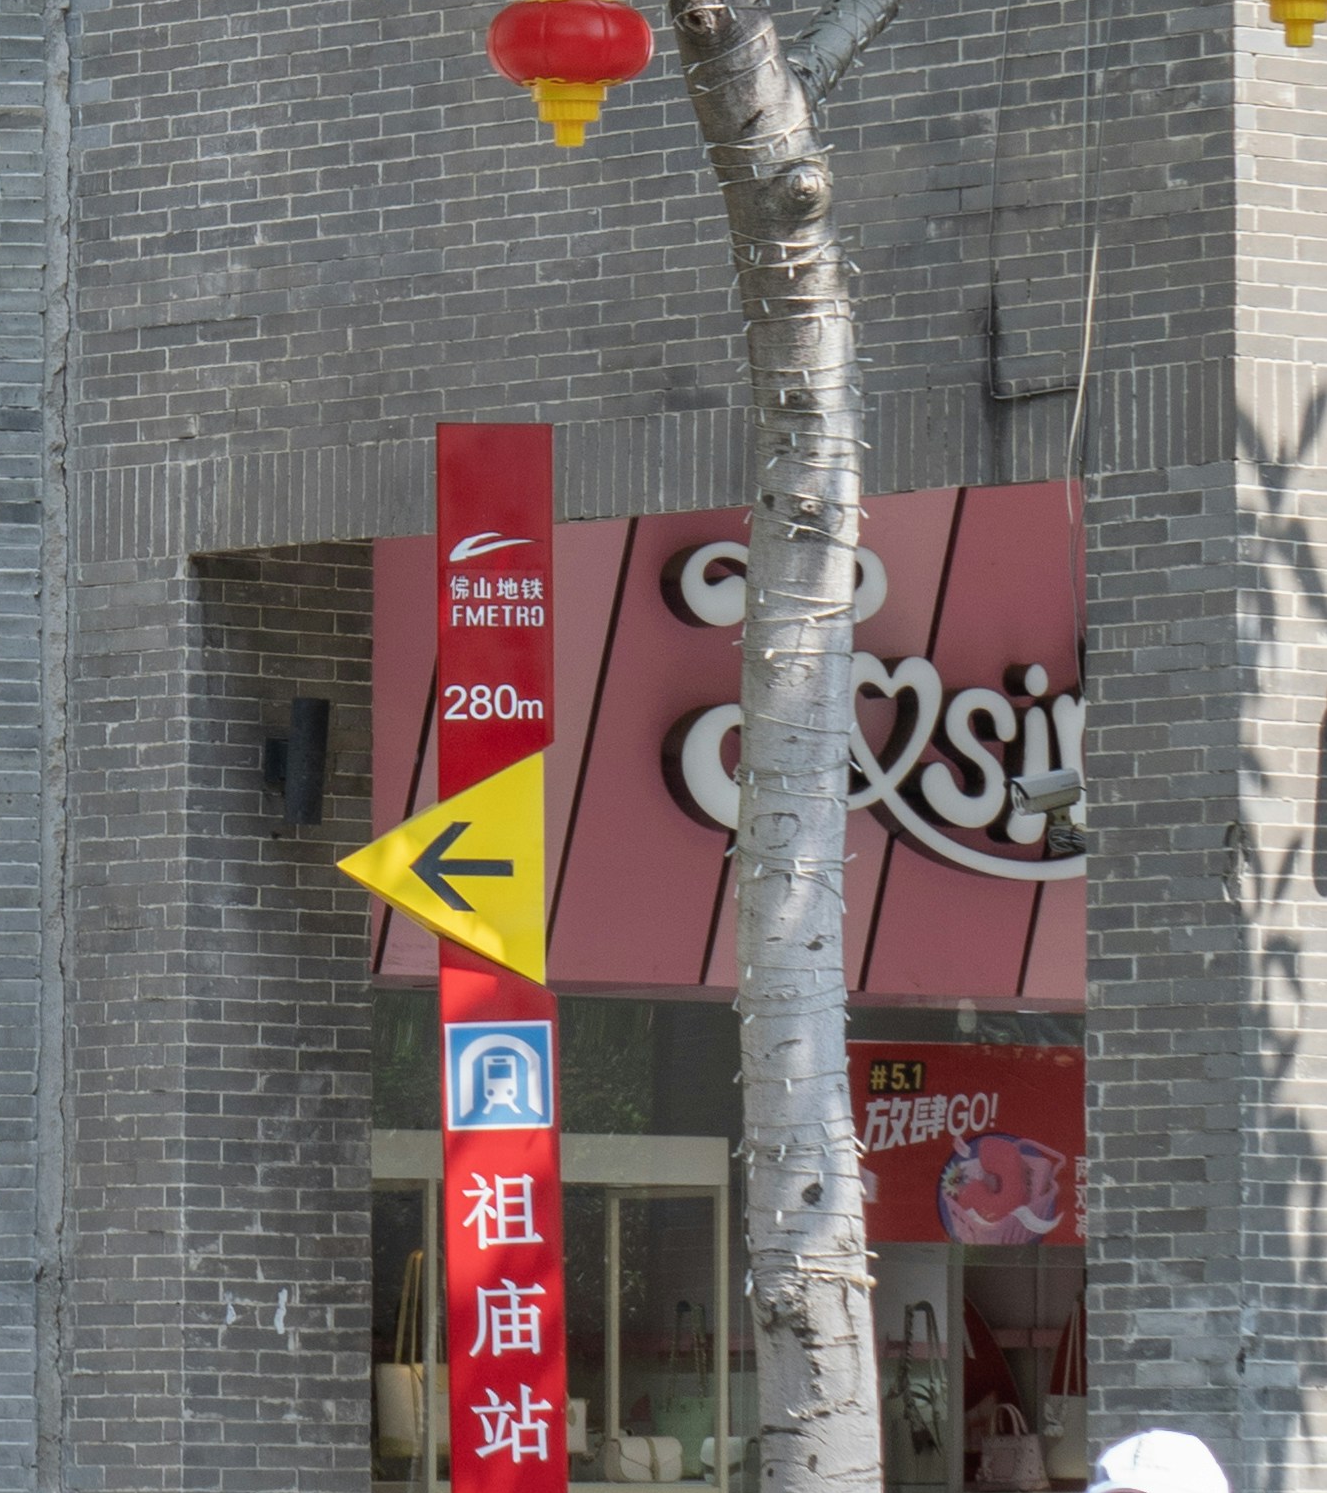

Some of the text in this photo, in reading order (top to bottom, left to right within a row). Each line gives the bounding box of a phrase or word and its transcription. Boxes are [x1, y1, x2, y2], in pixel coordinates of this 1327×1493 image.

[450, 575, 544, 600] 佛山地铁
[451, 605, 545, 627] FMETRO
[444, 683, 544, 720] 280m
[462, 1173, 553, 1463] 祖庙站
